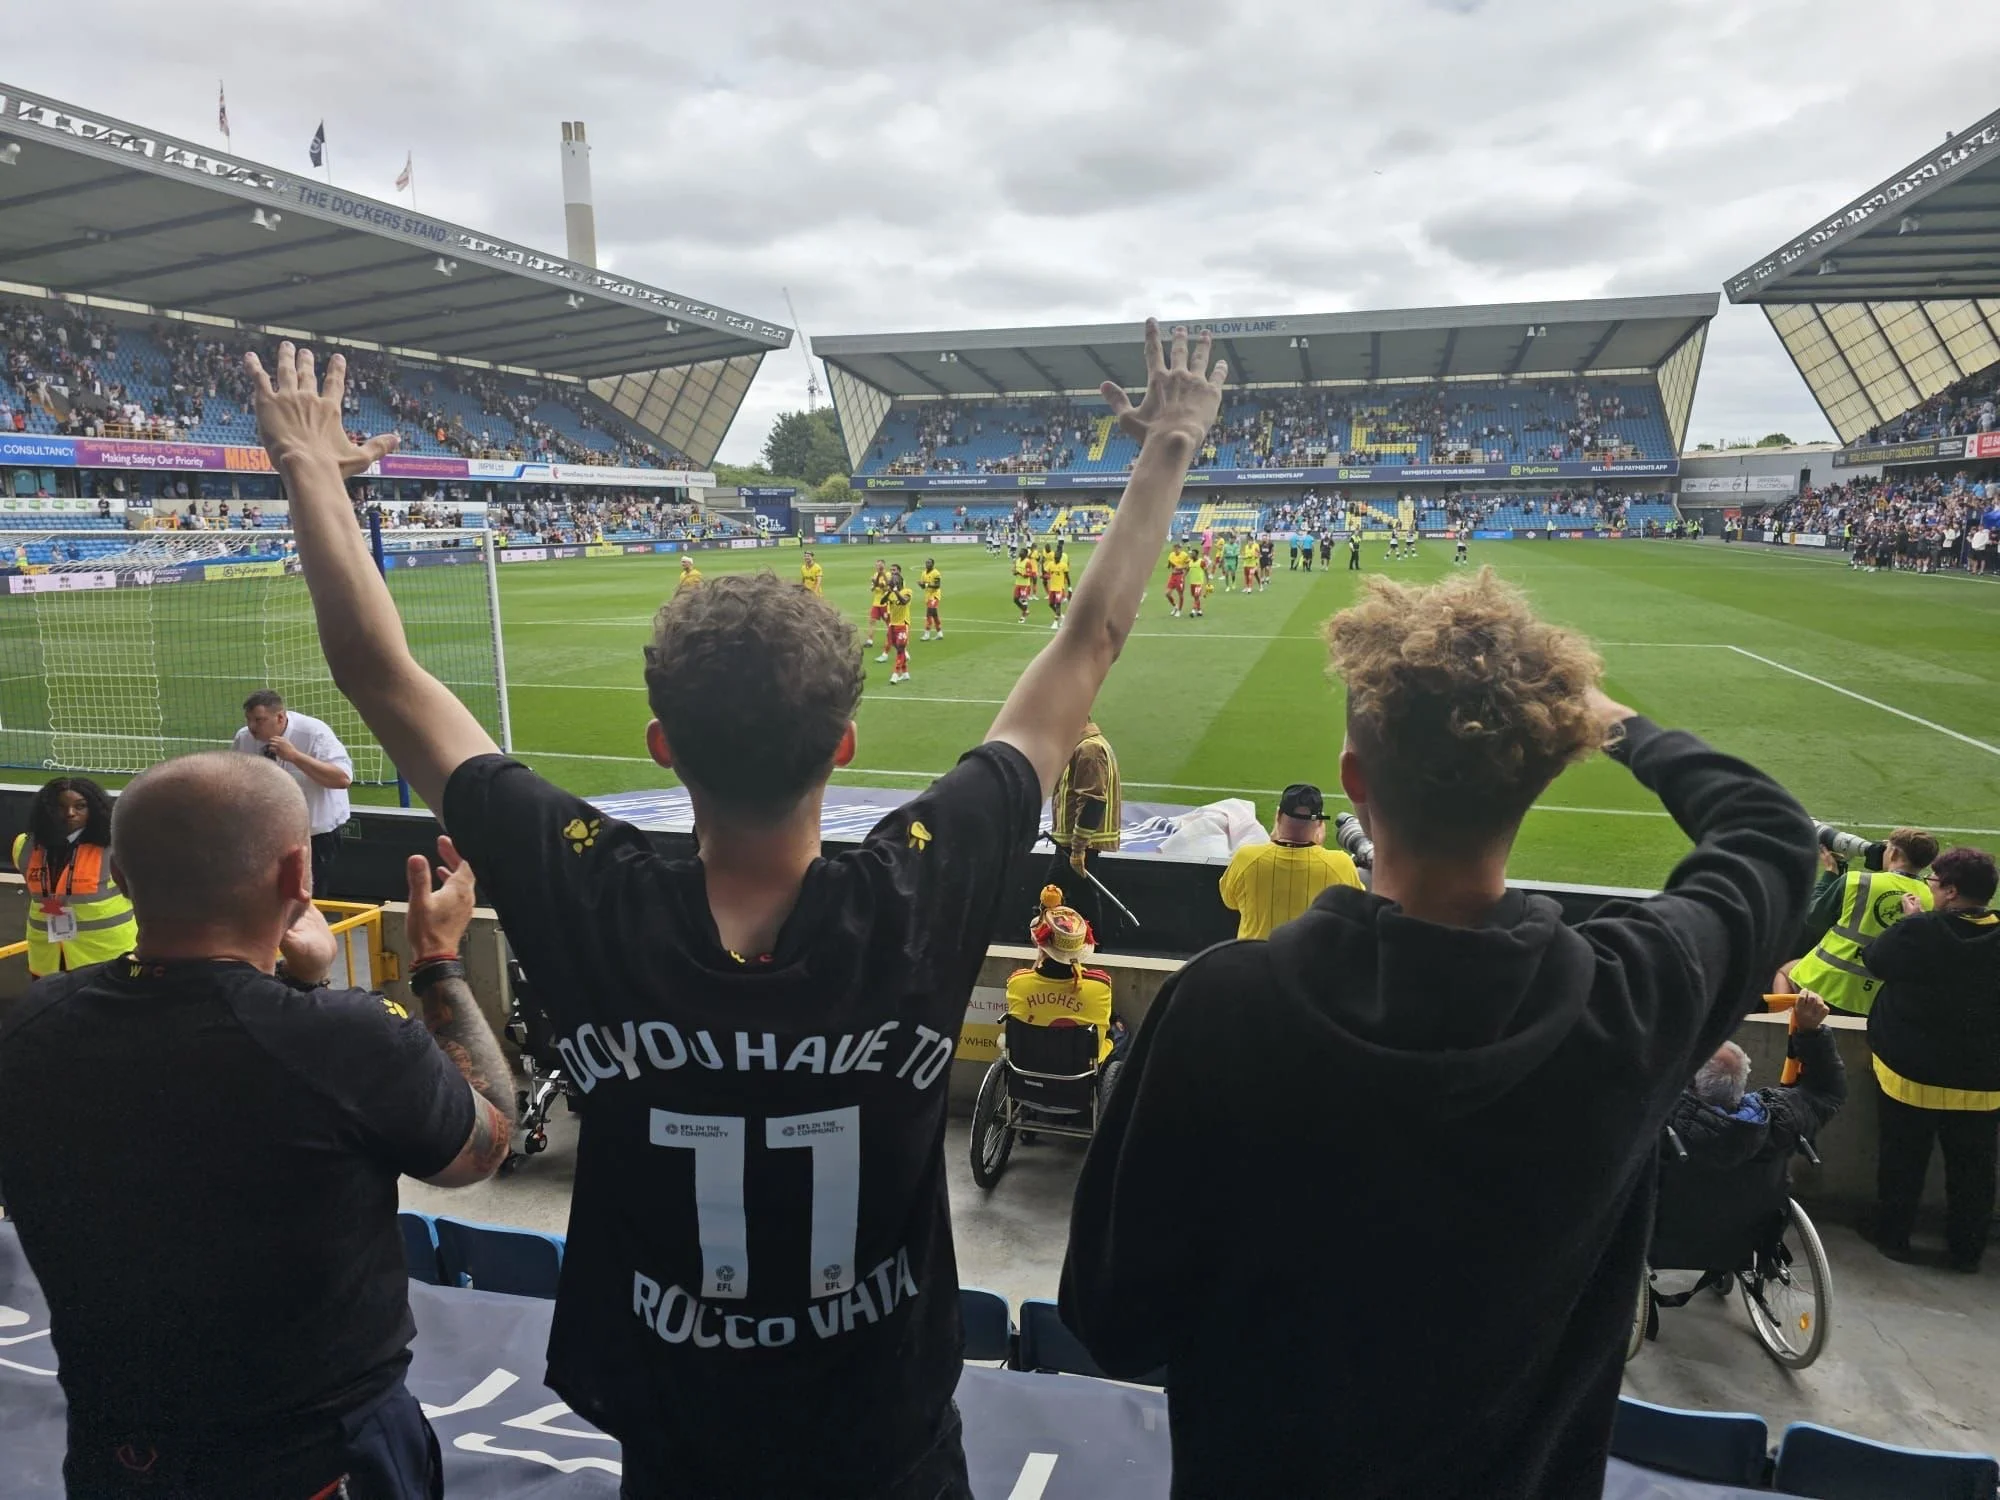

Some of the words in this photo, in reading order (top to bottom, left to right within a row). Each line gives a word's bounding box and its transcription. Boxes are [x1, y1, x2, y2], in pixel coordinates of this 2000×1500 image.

[300, 186, 328, 208] THE
[331, 196, 400, 229] DOCKERS
[403, 218, 446, 242] STAND
[1169, 325, 1202, 335] CLD
[1206, 323, 1242, 334] BLOW
[1246, 321, 1277, 332] LANE
[3, 445, 75, 456] CONSULTANCY
[102, 453, 132, 466] Making
[133, 454, 156, 466] Safety
[157, 456, 174, 465] Our
[175, 456, 204, 468] Priority
[1522, 466, 1558, 474] MyGuava
[1862, 980, 1874, 992] 5
[966, 1001, 985, 1010] ALL
[1026, 992, 1084, 1013] HUGHES
[965, 1038, 998, 1048] WHEN
[896, 1024, 953, 1090] TO
[822, 1120, 836, 1128] THE
[680, 1130, 729, 1138] COMMUNITY
[797, 1126, 845, 1136] COMMUNITY
[650, 1105, 860, 1300] 11
[716, 1282, 732, 1292] EFL
[825, 1282, 842, 1291] EFL
[632, 1269, 796, 1349] ROCCO
